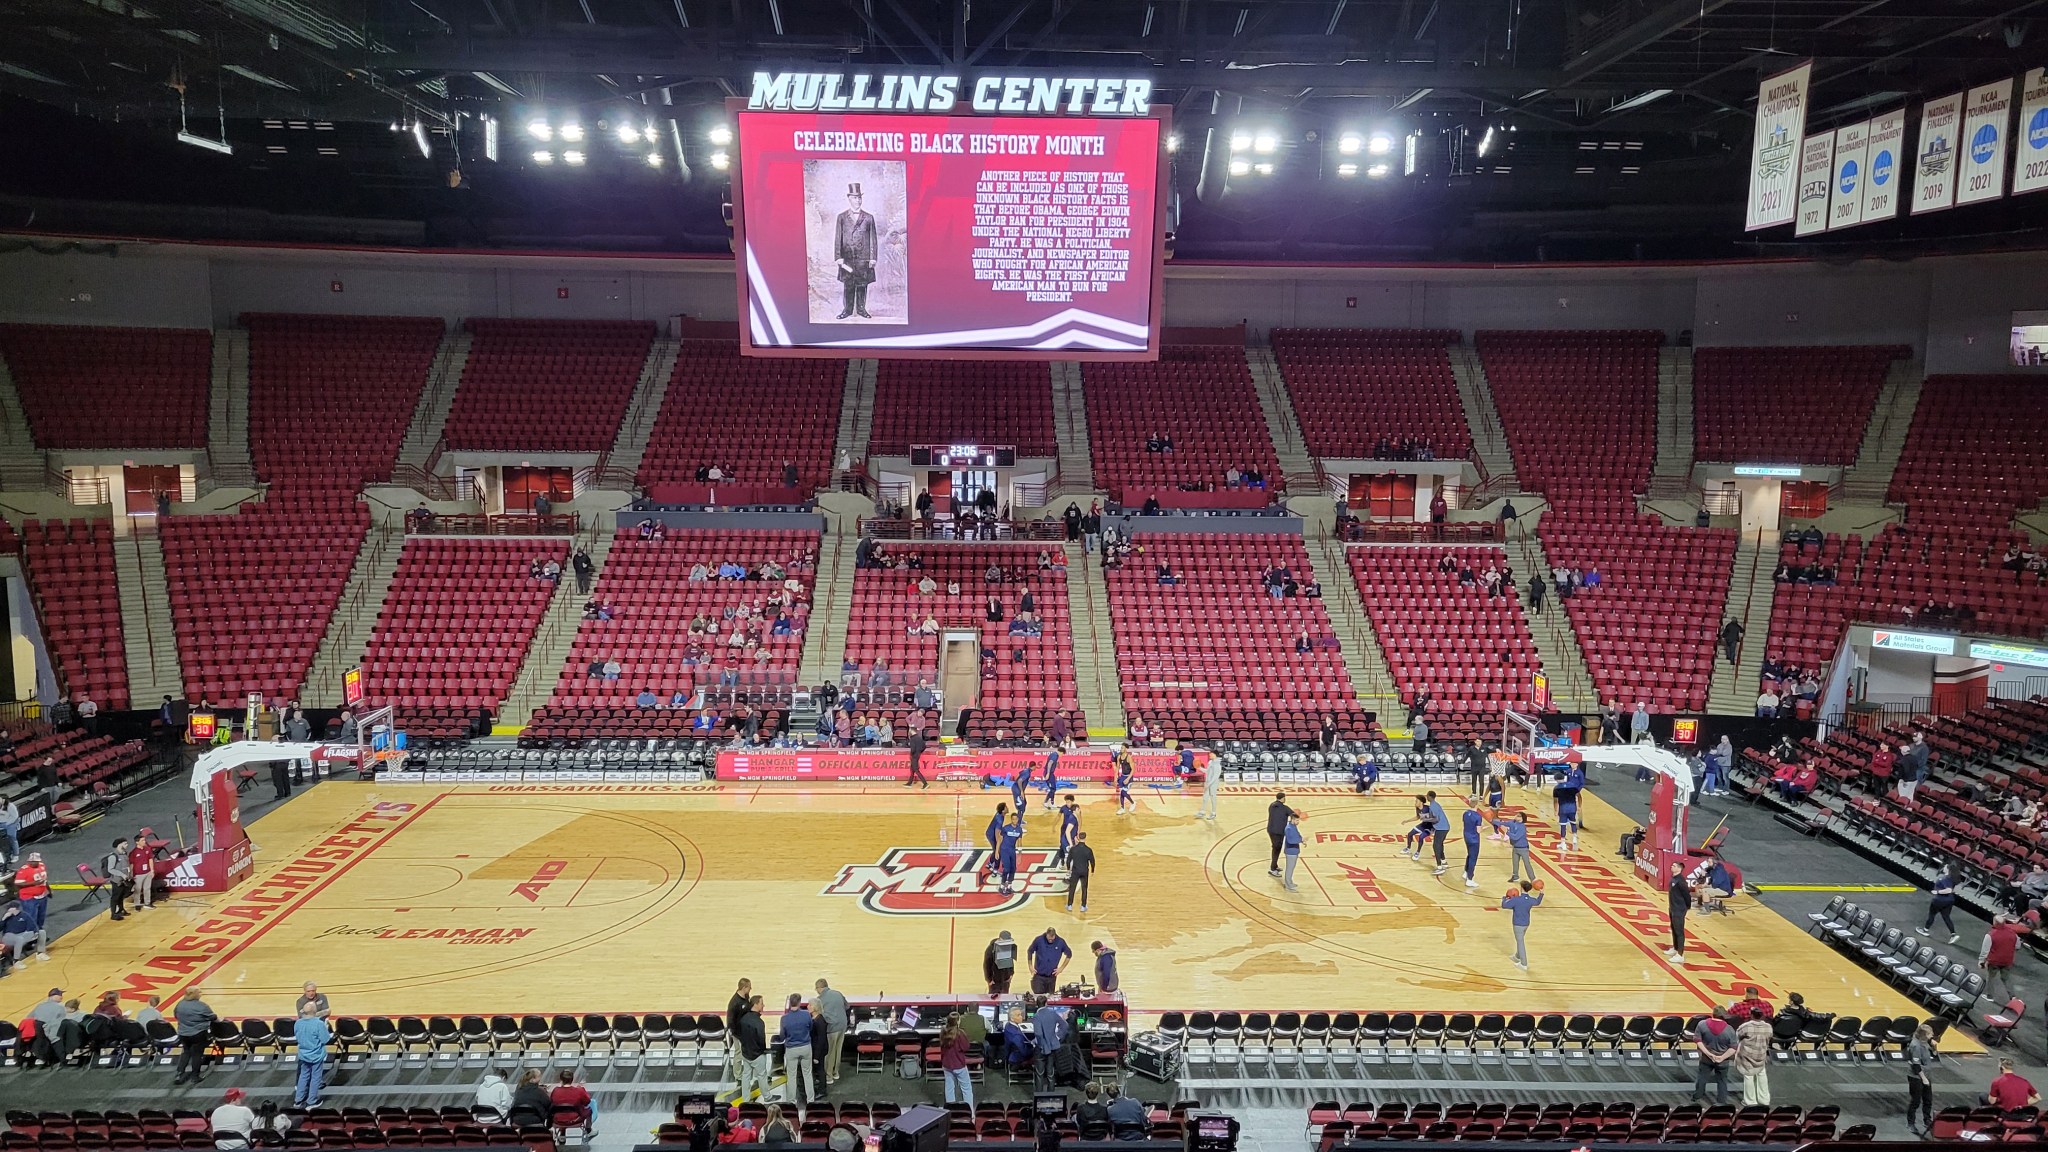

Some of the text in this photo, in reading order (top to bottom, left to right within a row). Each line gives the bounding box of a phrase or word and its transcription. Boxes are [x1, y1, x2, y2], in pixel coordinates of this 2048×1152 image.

[746, 71, 1152, 116] MULLINS CENTER
[1768, 79, 1799, 102] NATIONAL
[1980, 90, 1998, 104] NCAA
[1763, 94, 1800, 117] CHAMPIONS
[1928, 102, 1955, 117] NATIONAL
[1968, 99, 2009, 118] TOURNAMENT
[1880, 119, 1893, 131] NCAA
[1927, 114, 1953, 130] FINALISTS
[1847, 131, 1859, 142] NCAA
[1870, 128, 1902, 144] TOURNAMENT
[794, 131, 1105, 156] CELEBRATING BLACK HISTORY MONTH
[1806, 140, 1826, 154] DIVISION
[1837, 138, 1867, 155] TOURNAMENT
[1806, 149, 1828, 163] NATIONAL
[1803, 158, 1829, 173] CHAMPIONS
[981, 171, 1124, 183] ANOTHER PIECE OF HISTORY THAT
[1969, 173, 1992, 191] 2021
[977, 182, 1128, 194] CAN BE INCLUDED AS ONE OF THOSE
[1802, 181, 1826, 200] ECAC
[1923, 183, 1943, 200] 2019
[976, 194, 1128, 205] UNKNOWN BLACK HISTORY FACTS IS
[1760, 189, 1782, 212] 2021
[1871, 194, 1888, 211] 2019
[974, 205, 996, 214] THAT
[999, 205, 1030, 215] BEFORE
[1067, 206, 1098, 216] GEORGE
[1101, 206, 1130, 216] EDWIN
[1837, 202, 1854, 218] 2007
[975, 216, 1127, 227] TAYLOR RAN FOR PRESIDENT IN 1904
[1804, 210, 1818, 225] 1972
[972, 226, 1131, 238] UNDER THE NATIONAL NEGRO LIBERTY
[989, 238, 1017, 248] PARTY.
[1020, 238, 1031, 248] HE
[1035, 239, 1053, 248] WAS
[1056, 239, 1062, 248] A
[1027, 249, 1044, 259] AND
[1047, 249, 1096, 259] NEWSPAPER
[1100, 250, 1129, 260] EDITOR
[972, 259, 1128, 271] WHO FOUGHT FOR AFRICAN AMERICAN
[975, 270, 1125, 281] RIGHTS. HE WAS THE FIRST AFRICAN
[992, 281, 1107, 292] AMERICAN MAN TO RUN FOR
[1026, 292, 1073, 301] PRESIDENT.
[949, 445, 978, 457] 23:06
[941, 454, 949, 466] 0
[986, 455, 994, 466] 0
[1893, 634, 1925, 644] All States
[1892, 641, 1948, 653] Materials Group
[192, 717, 212, 725] 23:06
[1676, 721, 1694, 730] 23:06
[196, 724, 209, 735] 30
[1678, 729, 1691, 739] 30
[323, 748, 358, 758] #FLAGSHI
[750, 758, 795, 766] HANGAR
[818, 760, 869, 770] OFFICIAL
[872, 760, 930, 770] GAMEDY
[993, 760, 1008, 770] OF
[488, 785, 726, 793] UMASSATHLETICS.COM
[96, 801, 418, 1003] MASSACHUSETTS
[313, 924, 538, 939] Jack LEAMAN
